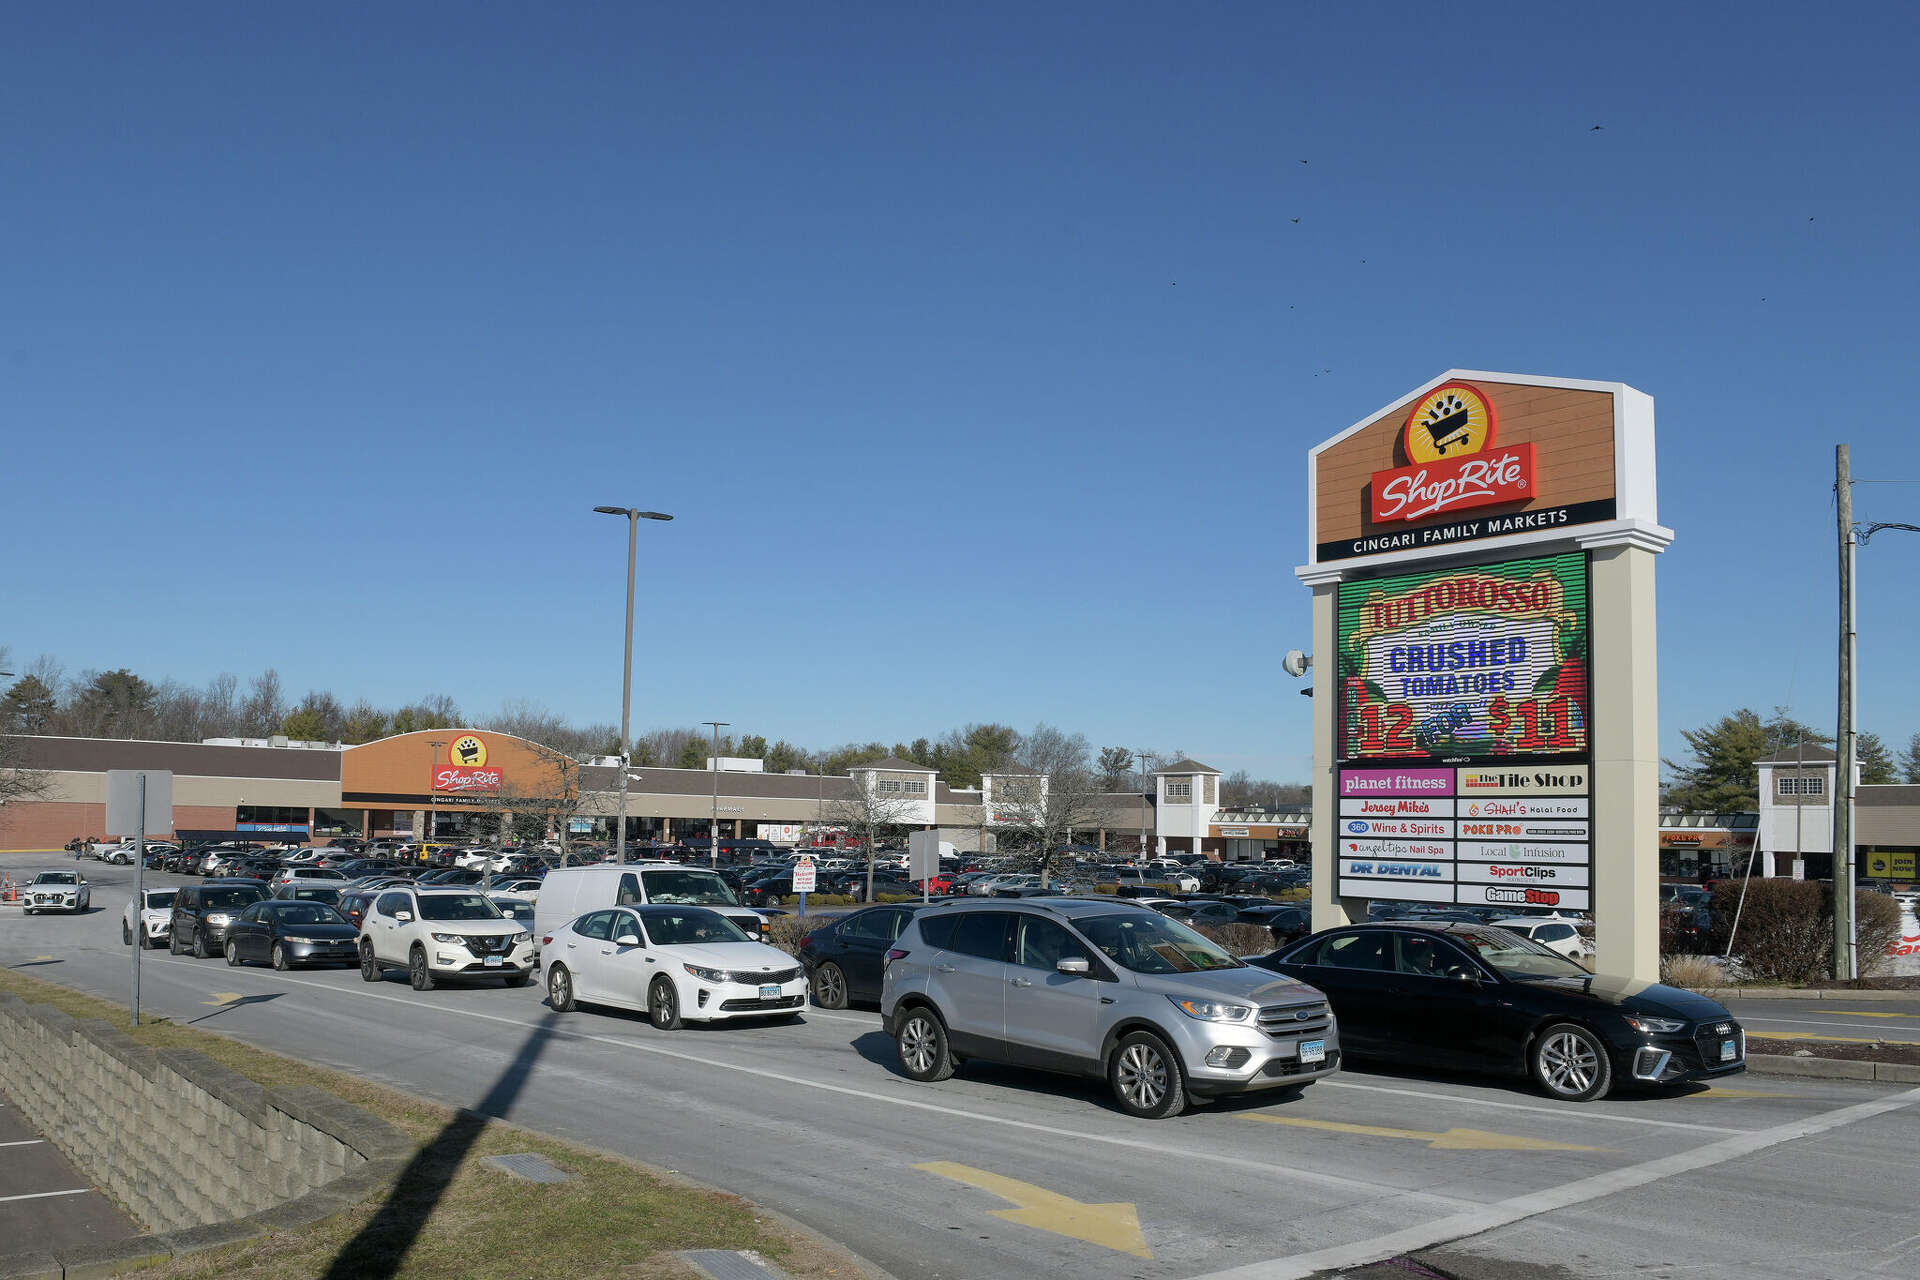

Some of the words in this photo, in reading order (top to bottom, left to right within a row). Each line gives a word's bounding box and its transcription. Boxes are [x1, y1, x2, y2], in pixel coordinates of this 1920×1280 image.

[1379, 453, 1521, 518] ShopRite
[1353, 533, 1416, 553] CINGARI
[1423, 523, 1480, 543] FAMILY
[1488, 509, 1568, 533] MARKETS
[1369, 577, 1550, 628] TUTTOROSSO
[1390, 635, 1526, 672] CRUSHED
[1400, 670, 1515, 697] TOMATOES
[1360, 703, 1414, 750] 12
[1420, 703, 1473, 745] FOR
[1488, 696, 1577, 749] $11
[435, 770, 500, 791] ShopRite
[1345, 775, 1392, 793] planet
[1395, 775, 1447, 789] fitness
[1480, 774, 1499, 783] the
[1499, 773, 1531, 788] Tile
[1534, 773, 1583, 788] Shop
[1361, 801, 1396, 816] Jersey
[1398, 801, 1430, 813] Mike's
[1351, 823, 1367, 832] 360
[1372, 822, 1398, 833] Wine
[1400, 823, 1408, 833] &
[1410, 823, 1445, 835] Spirits
[1463, 824, 1494, 835] POKE
[1409, 845, 1426, 854] Nail
[1428, 845, 1445, 855] Spa
[1480, 846, 1507, 857] Local
[1523, 847, 1566, 858] Infusion
[1350, 862, 1374, 874] DR
[1377, 863, 1442, 877] DENTAL
[1489, 865, 1556, 879] SportClips
[1485, 886, 1560, 906] GameStop
